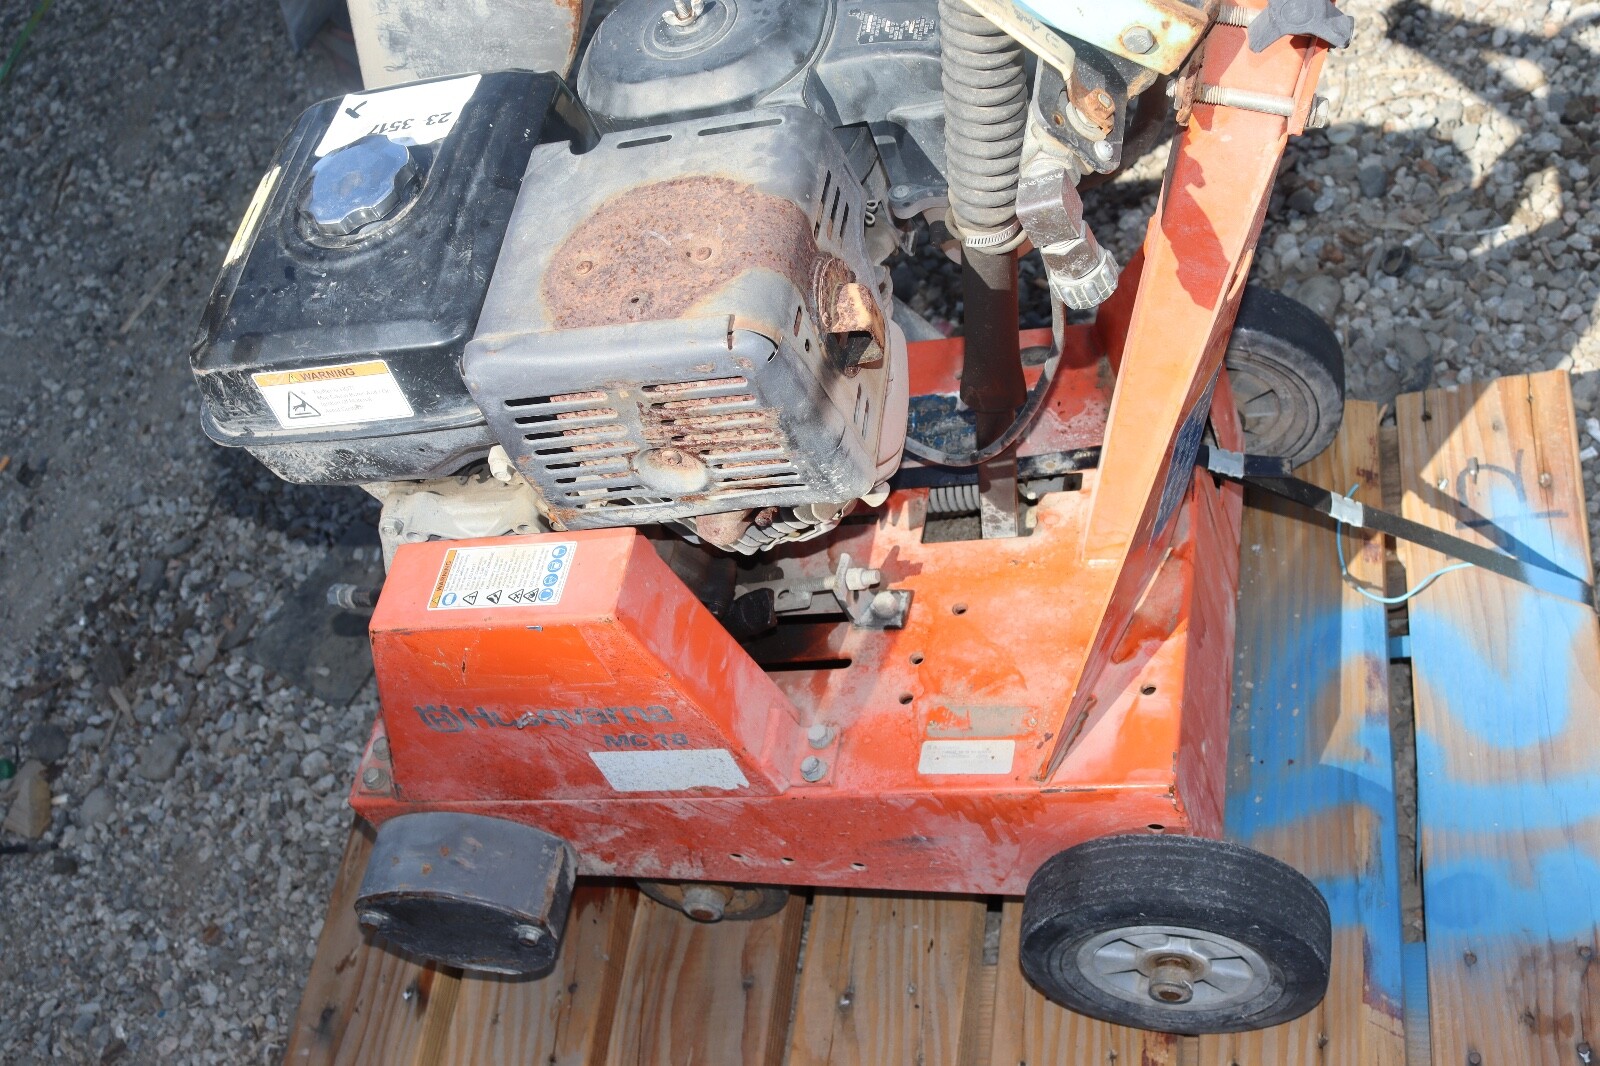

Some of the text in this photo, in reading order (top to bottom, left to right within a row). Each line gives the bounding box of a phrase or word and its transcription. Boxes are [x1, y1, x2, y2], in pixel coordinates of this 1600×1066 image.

[425, 111, 453, 126] 23
[300, 367, 356, 381] WARNING
[436, 560, 452, 592] WARNING
[603, 733, 689, 748] MC 18
